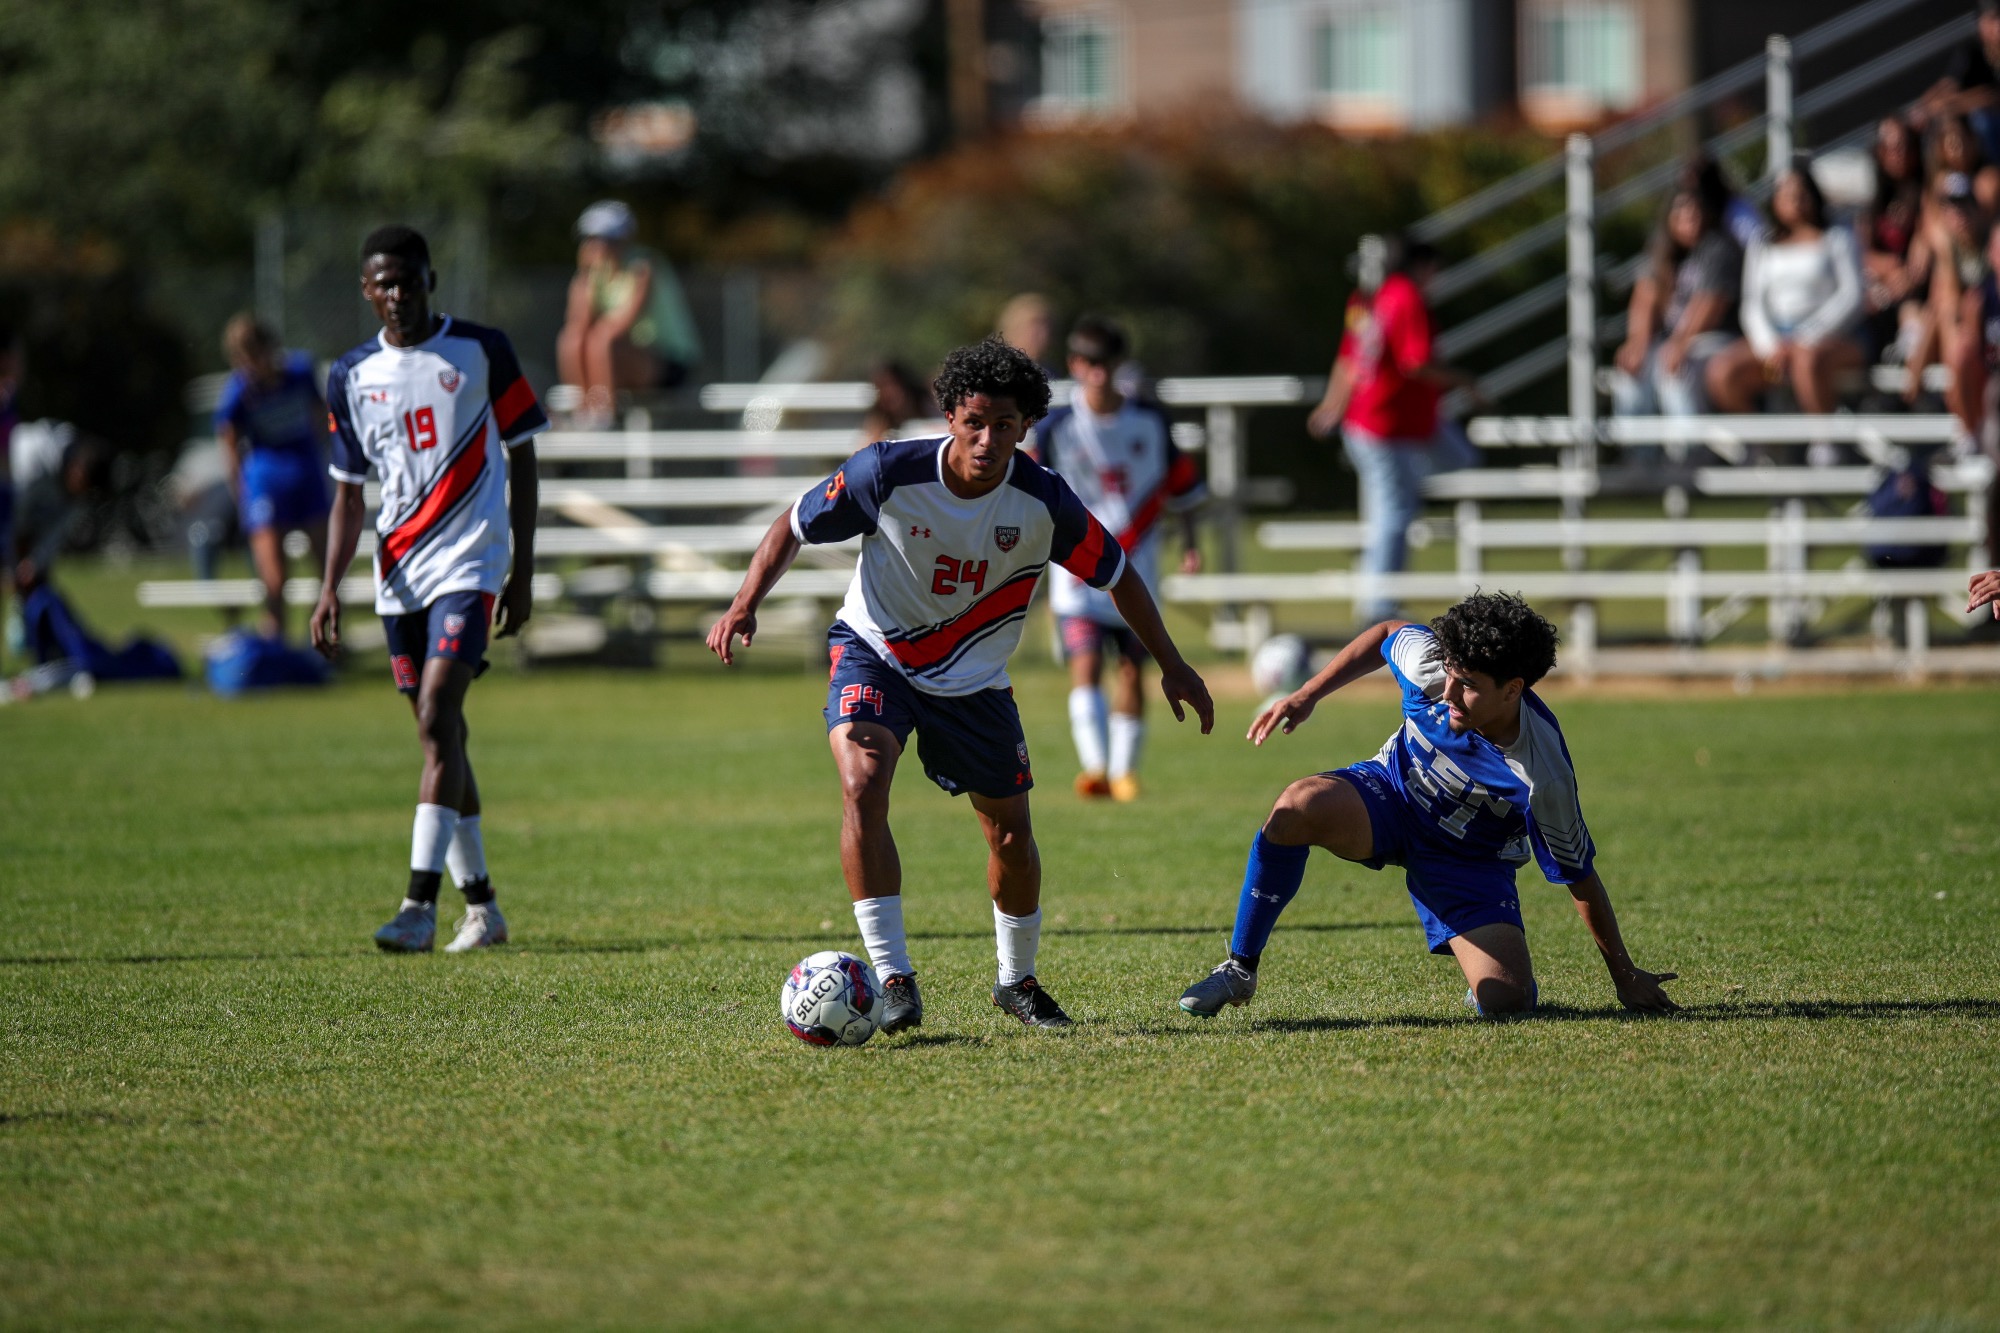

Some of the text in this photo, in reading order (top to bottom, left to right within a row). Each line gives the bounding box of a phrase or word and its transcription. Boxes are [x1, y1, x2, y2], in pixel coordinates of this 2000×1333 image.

[404, 404, 438, 453] 19
[930, 554, 989, 596] 24
[390, 654, 419, 688] 19
[839, 683, 884, 717] 24
[796, 973, 838, 1021] SELECT
